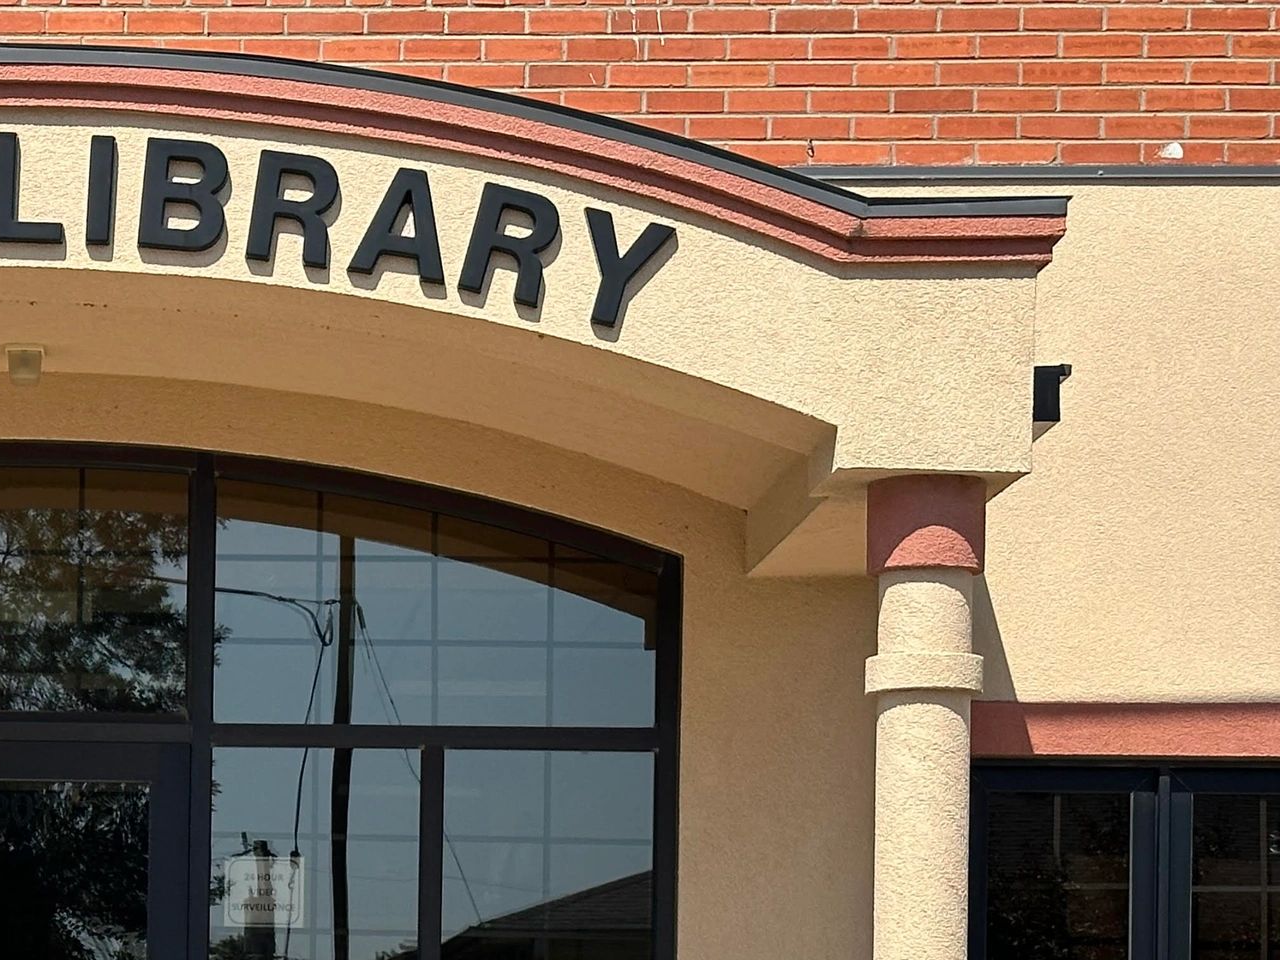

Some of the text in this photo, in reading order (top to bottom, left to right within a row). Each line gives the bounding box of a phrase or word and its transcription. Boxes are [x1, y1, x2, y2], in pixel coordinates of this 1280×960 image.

[257, 873, 283, 881] HOUR
[248, 887, 277, 896] VIDEO
[231, 903, 296, 912] SURVEILLANCE
